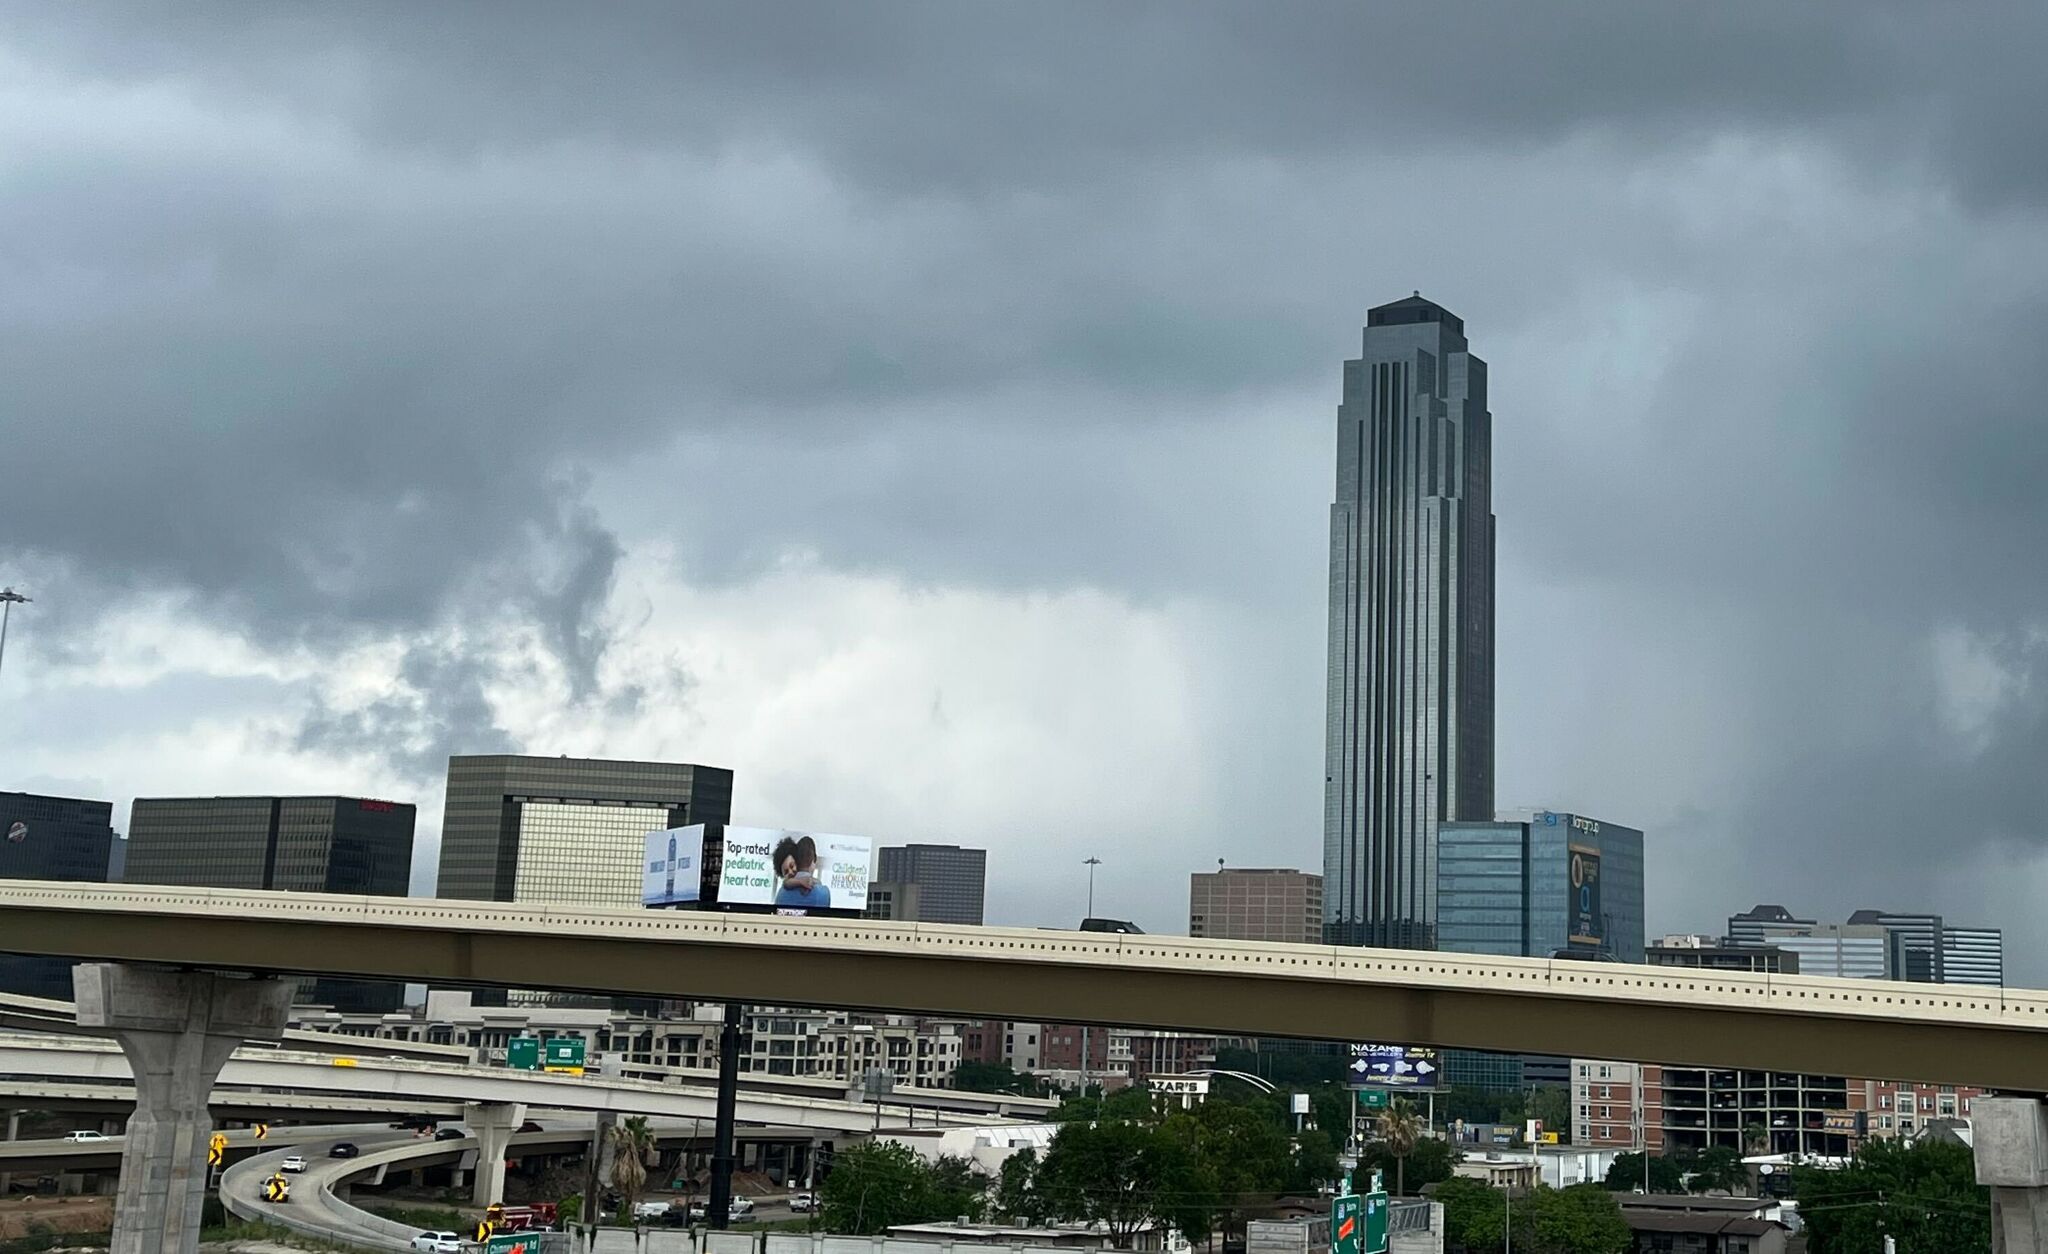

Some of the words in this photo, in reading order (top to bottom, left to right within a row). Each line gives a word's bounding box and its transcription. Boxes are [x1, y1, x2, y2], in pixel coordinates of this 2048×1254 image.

[726, 840, 770, 857] Top-rated
[725, 857, 765, 875] pediatric
[724, 874, 749, 886] heart
[1149, 1081, 1198, 1092] AZAR'S
[1825, 1117, 1854, 1128] NTB
